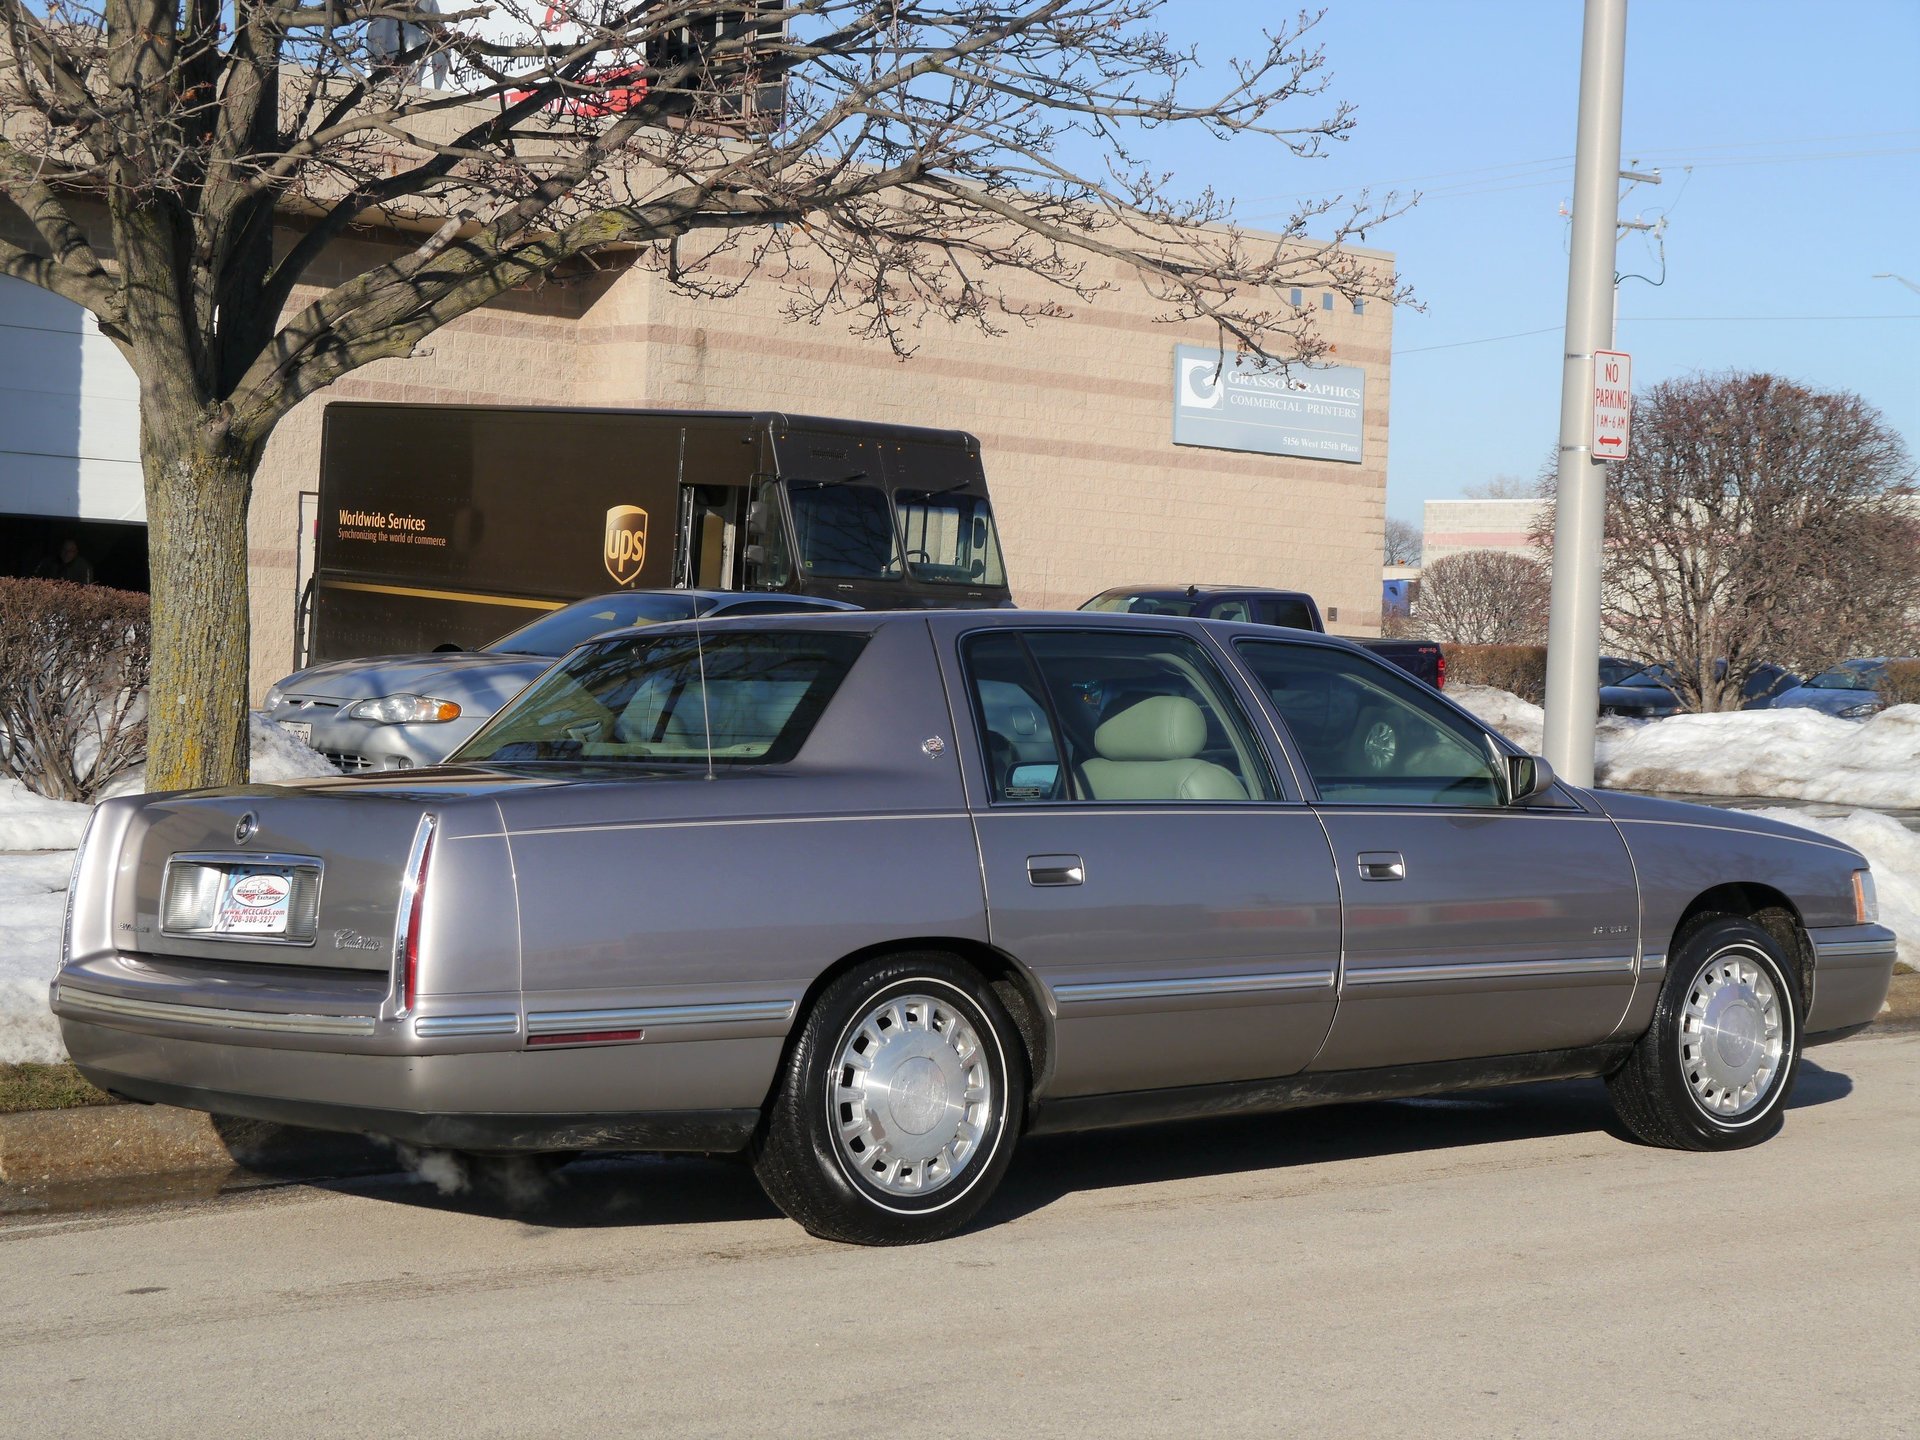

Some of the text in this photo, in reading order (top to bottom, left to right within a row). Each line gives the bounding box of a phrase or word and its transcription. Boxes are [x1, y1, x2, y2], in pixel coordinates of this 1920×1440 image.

[1605, 364, 1618, 383] NO
[1230, 394, 1357, 418] COMMERCIAL PRINTERS
[1596, 388, 1627, 410] PARKING
[1282, 436, 1359, 453] 5156 West 125th Place
[339, 509, 426, 531] Worldwide Services
[338, 527, 446, 546] Synchronizing the world of commerce
[608, 529, 644, 573] ups
